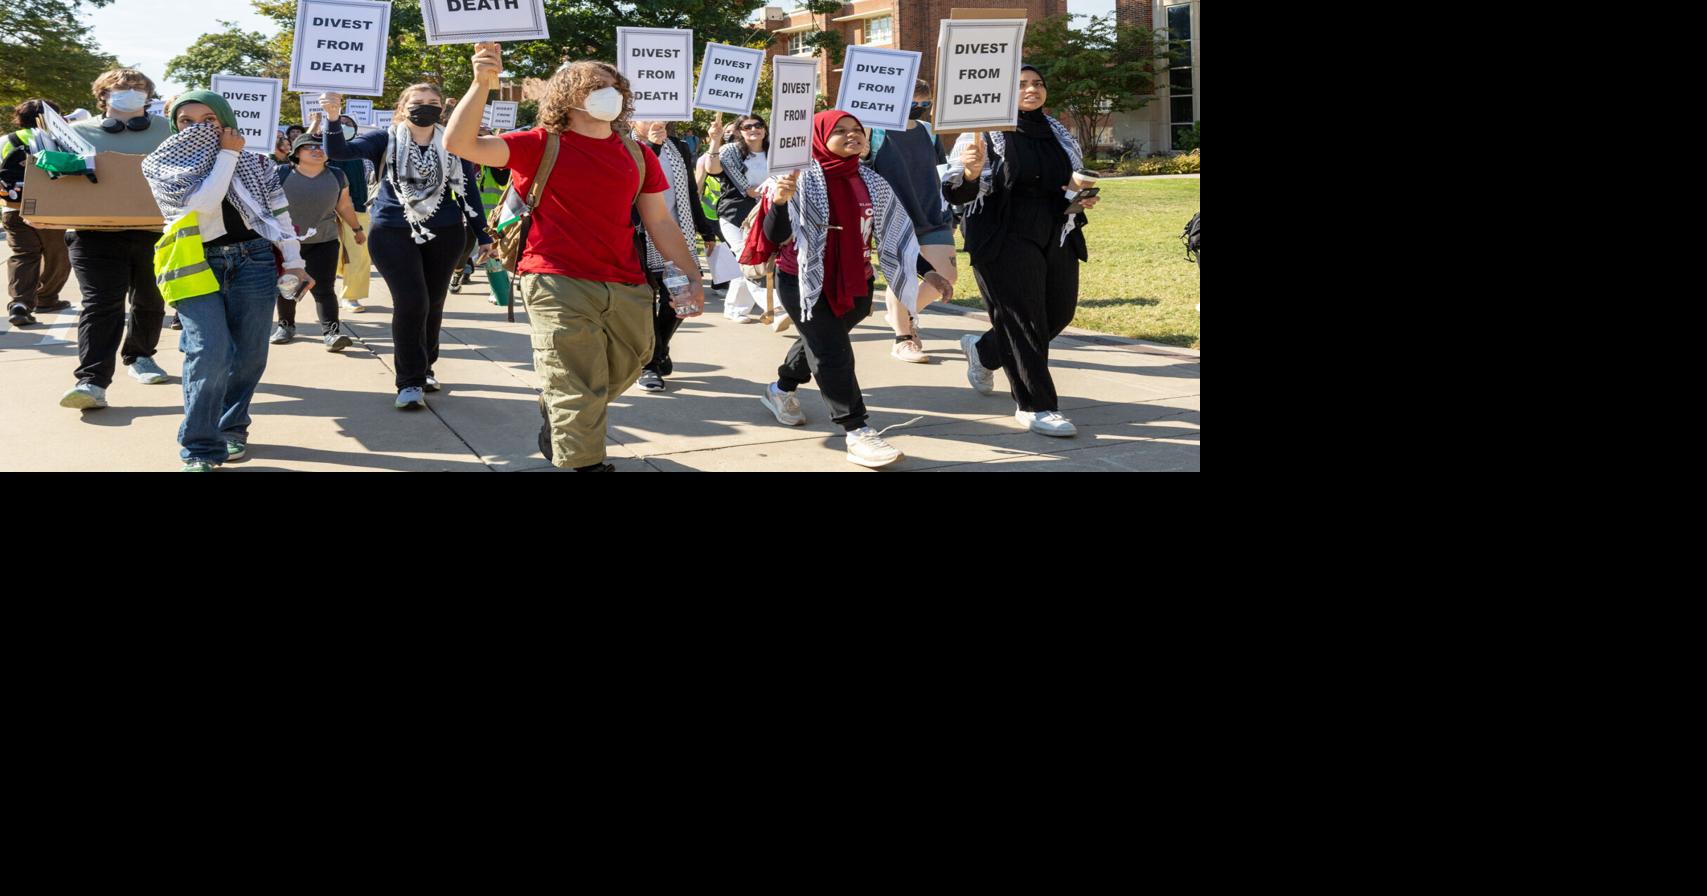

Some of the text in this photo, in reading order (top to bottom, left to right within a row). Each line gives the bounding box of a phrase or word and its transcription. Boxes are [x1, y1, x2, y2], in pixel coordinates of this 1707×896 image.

[446, 0, 519, 12] DEATH
[312, 17, 373, 30] DIVEST
[316, 39, 364, 52] FROM
[955, 43, 1008, 55] DIVEST
[631, 48, 681, 58] DIVEST
[310, 61, 366, 74] DEATH
[713, 57, 752, 70] DIVEST
[856, 63, 904, 76] DIVEST
[637, 69, 675, 79] FROM
[714, 73, 745, 84] FROM
[958, 68, 1000, 80] FROM
[708, 88, 743, 100] DEATH
[781, 82, 811, 94] DIVEST
[857, 82, 896, 94] FROM
[222, 91, 267, 102] DIVEST
[634, 91, 679, 101] DEATH
[953, 93, 1001, 105] DEATH
[850, 100, 895, 112] DEATH
[233, 110, 260, 119] ROM
[783, 110, 807, 121] FROM
[239, 127, 262, 136] ATH
[779, 136, 806, 149] DEATH
